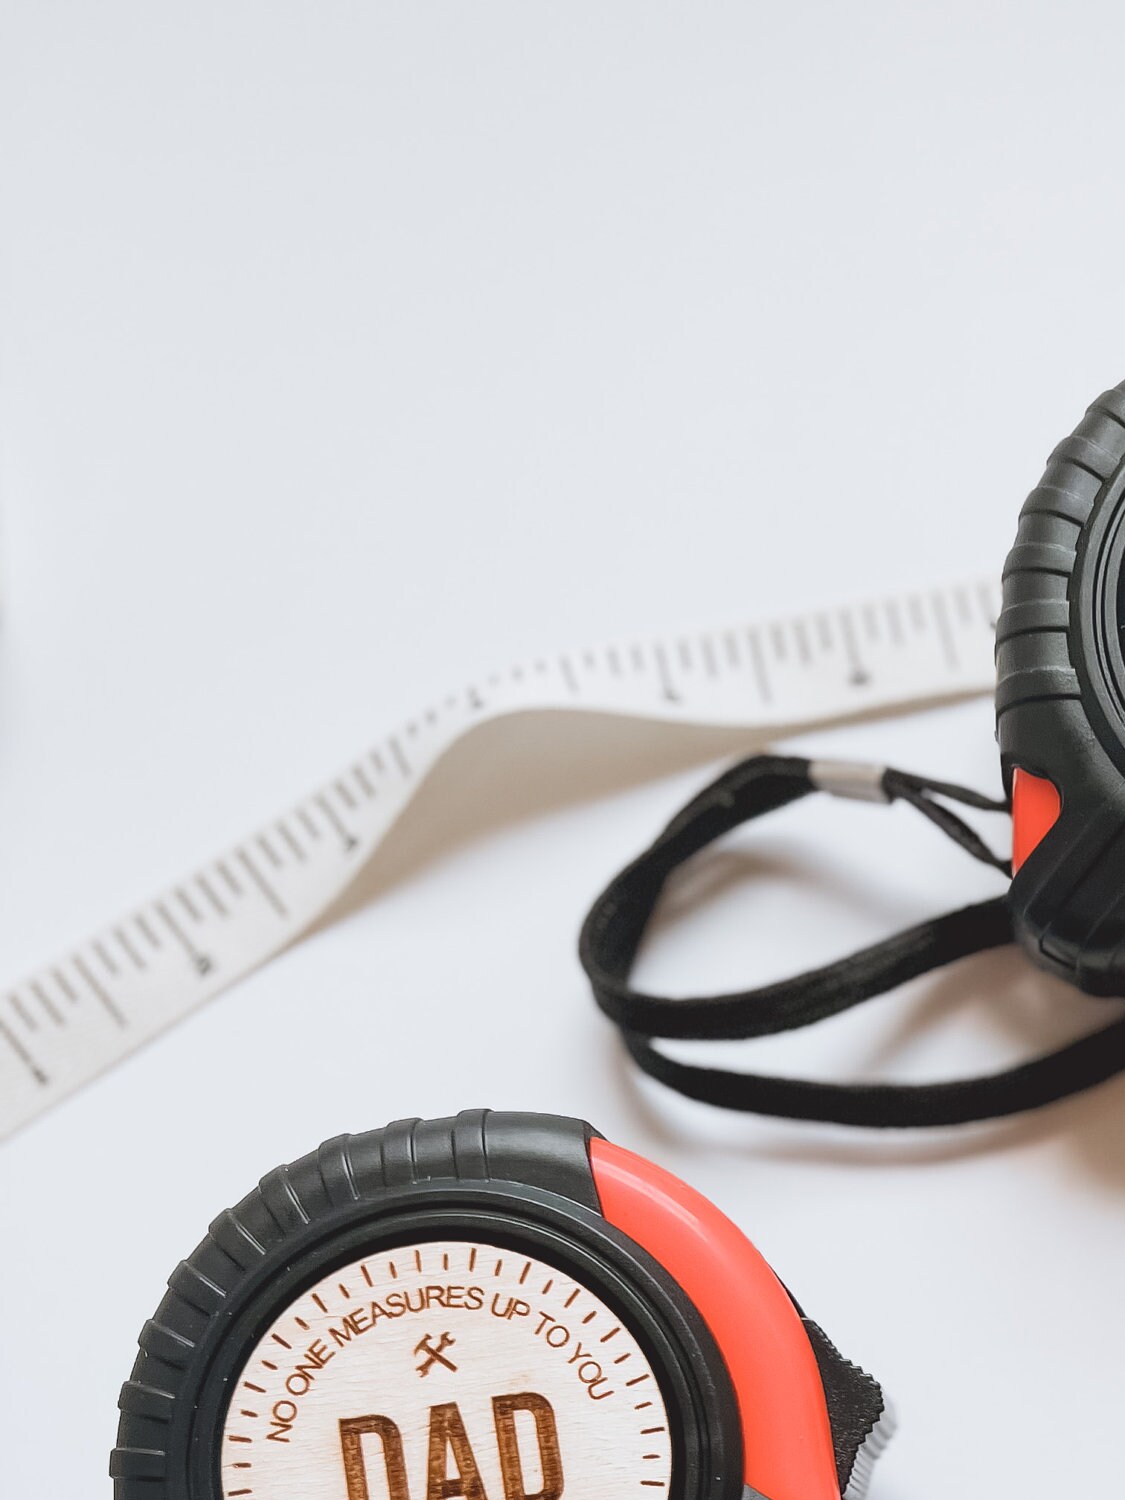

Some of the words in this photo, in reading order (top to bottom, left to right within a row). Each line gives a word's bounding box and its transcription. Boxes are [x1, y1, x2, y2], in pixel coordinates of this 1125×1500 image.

[266, 1399, 297, 1443] NO
[285, 1339, 336, 1396] ONE
[329, 1285, 485, 1348] MEASURES
[491, 1292, 531, 1321] UP
[535, 1312, 570, 1348] TO
[567, 1342, 615, 1400] YOU
